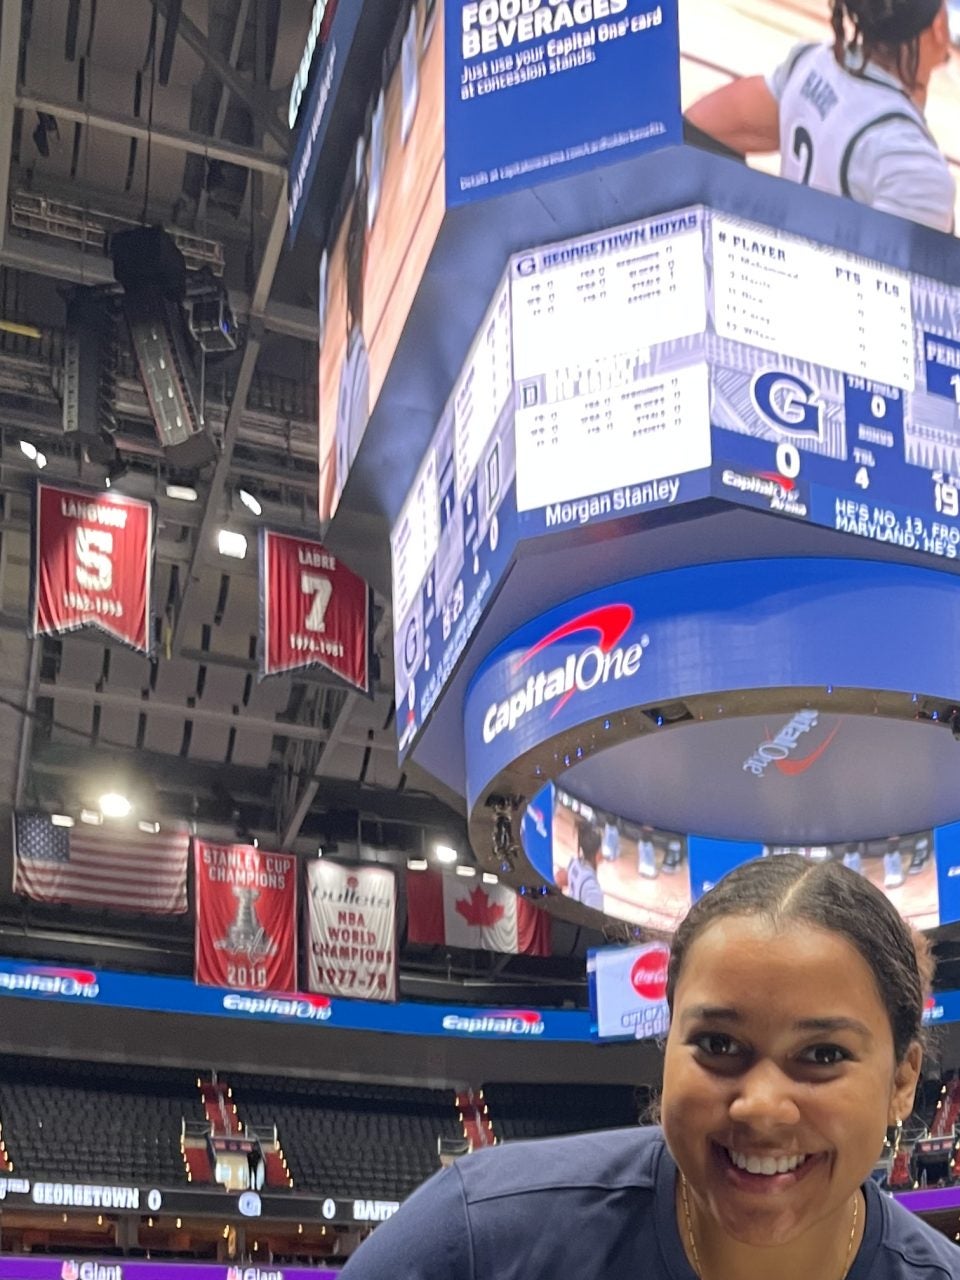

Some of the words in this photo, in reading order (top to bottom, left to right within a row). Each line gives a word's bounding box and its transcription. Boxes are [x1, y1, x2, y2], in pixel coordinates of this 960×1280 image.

[462, 0, 628, 59] BEVERAGES
[461, 60, 489, 84] Just
[491, 54, 514, 75] use
[515, 44, 544, 71] your
[547, 26, 596, 57] Capital
[477, 61, 547, 96] concession
[733, 235, 786, 261] PLAYER
[835, 266, 861, 285] PTS
[752, 370, 824, 440] G
[871, 395, 886, 418] 0
[775, 443, 800, 478] 0
[855, 466, 870, 489] 4
[545, 494, 611, 527] Morgan
[613, 478, 680, 510] Stanley
[835, 496, 869, 519] HE'S
[75, 526, 113, 592] 5
[298, 546, 336, 571] LABRE
[924, 537, 957, 559] HE'S
[301, 571, 333, 633] 7
[203, 848, 261, 871] STANLEY
[266, 856, 291, 875] CUP
[209, 866, 285, 890] CHAMPIONS
[338, 911, 366, 927] NBA
[328, 926, 376, 946] WORLD
[312, 942, 392, 965] CHAMPIONS
[33, 1182, 140, 1209] GEORGETOWN
[148, 1189, 162, 1211] 0
[322, 1198, 336, 1220] 0
